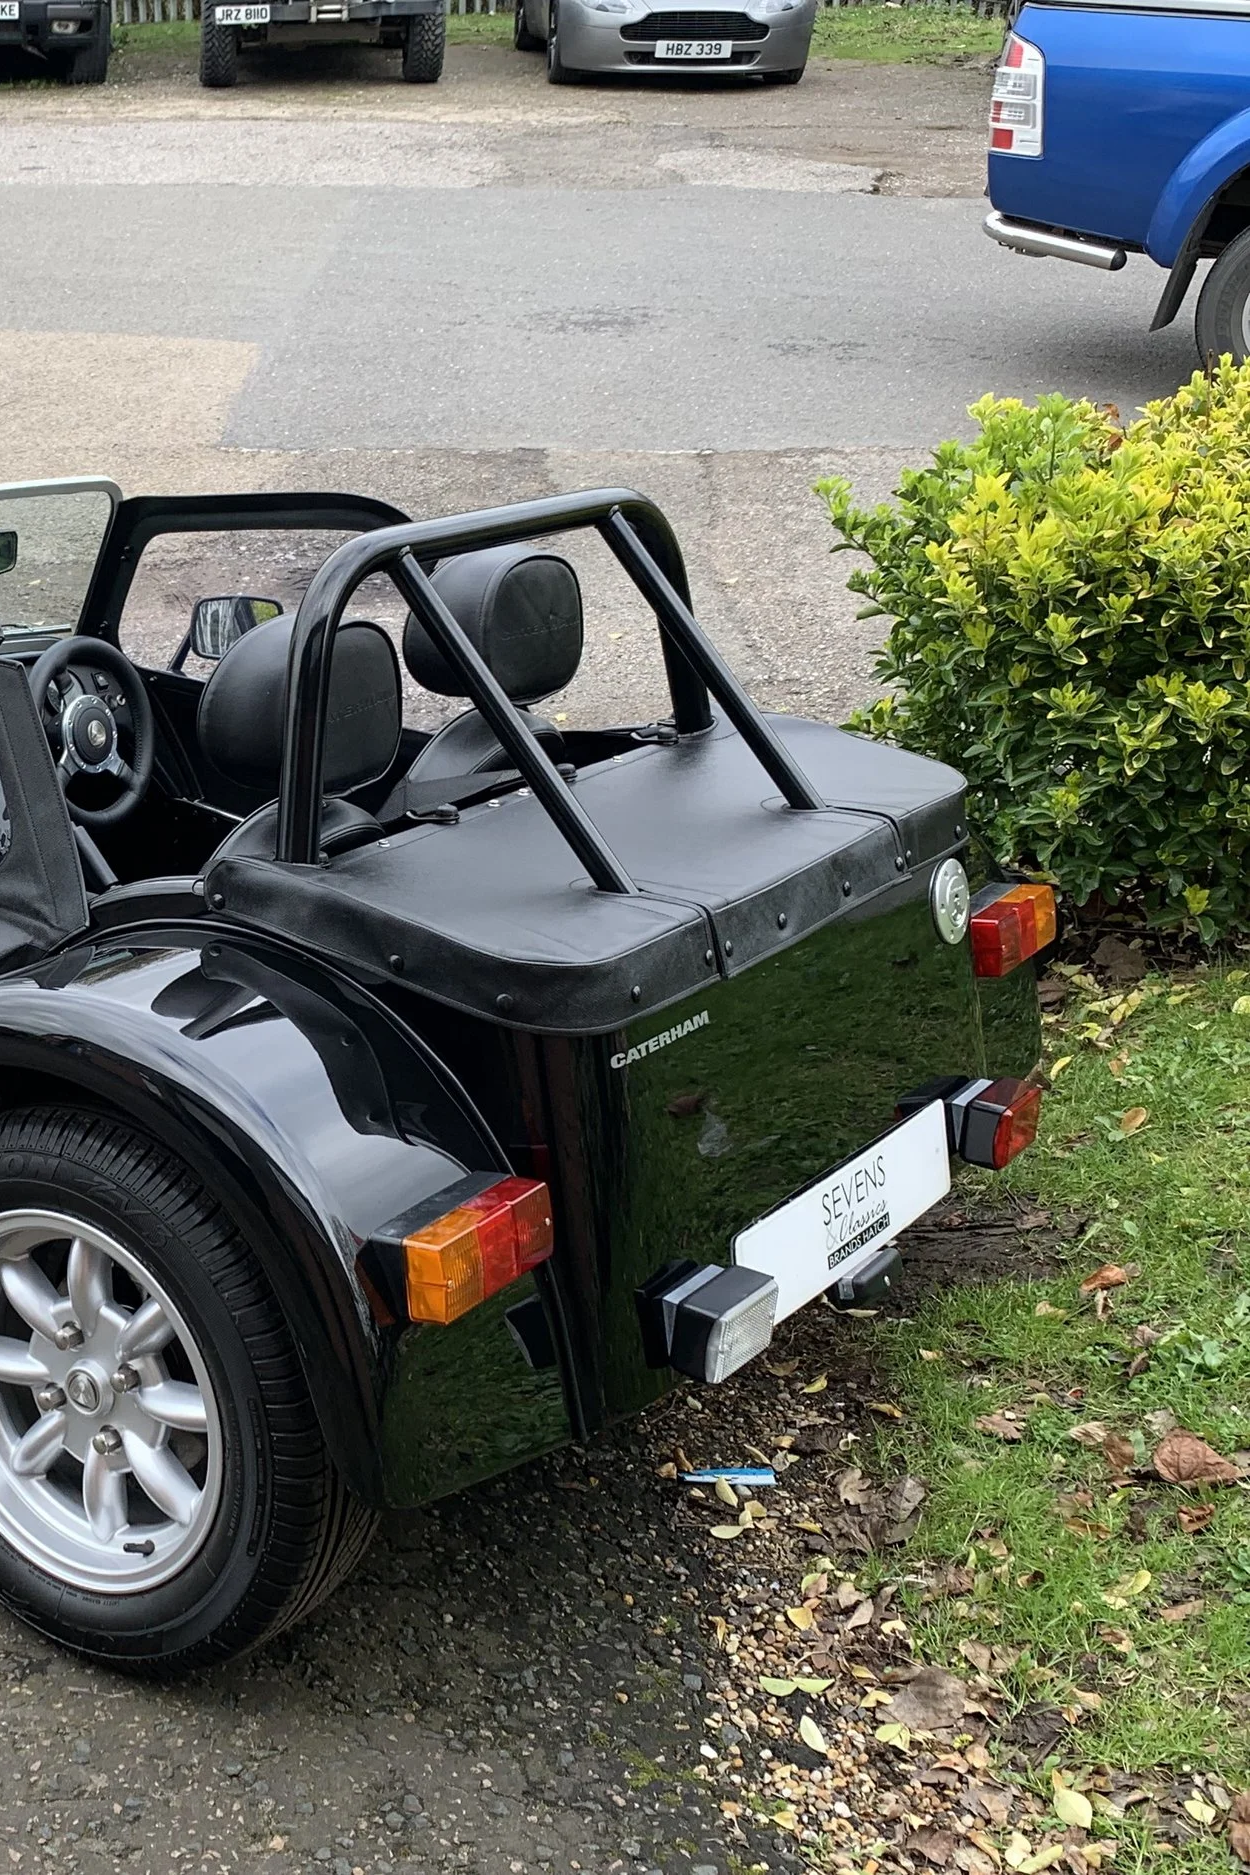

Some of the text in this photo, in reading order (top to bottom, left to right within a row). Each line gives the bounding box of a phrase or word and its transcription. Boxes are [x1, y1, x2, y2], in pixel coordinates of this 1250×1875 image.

[218, 7, 268, 22] JRZ 8110
[665, 43, 722, 56] HBZ 339
[610, 1009, 710, 1069] CATERHAM
[821, 1155, 887, 1226] SEVENS
[829, 1214, 890, 1268] BRANDS HATCH
[838, 1199, 889, 1243] Classics
